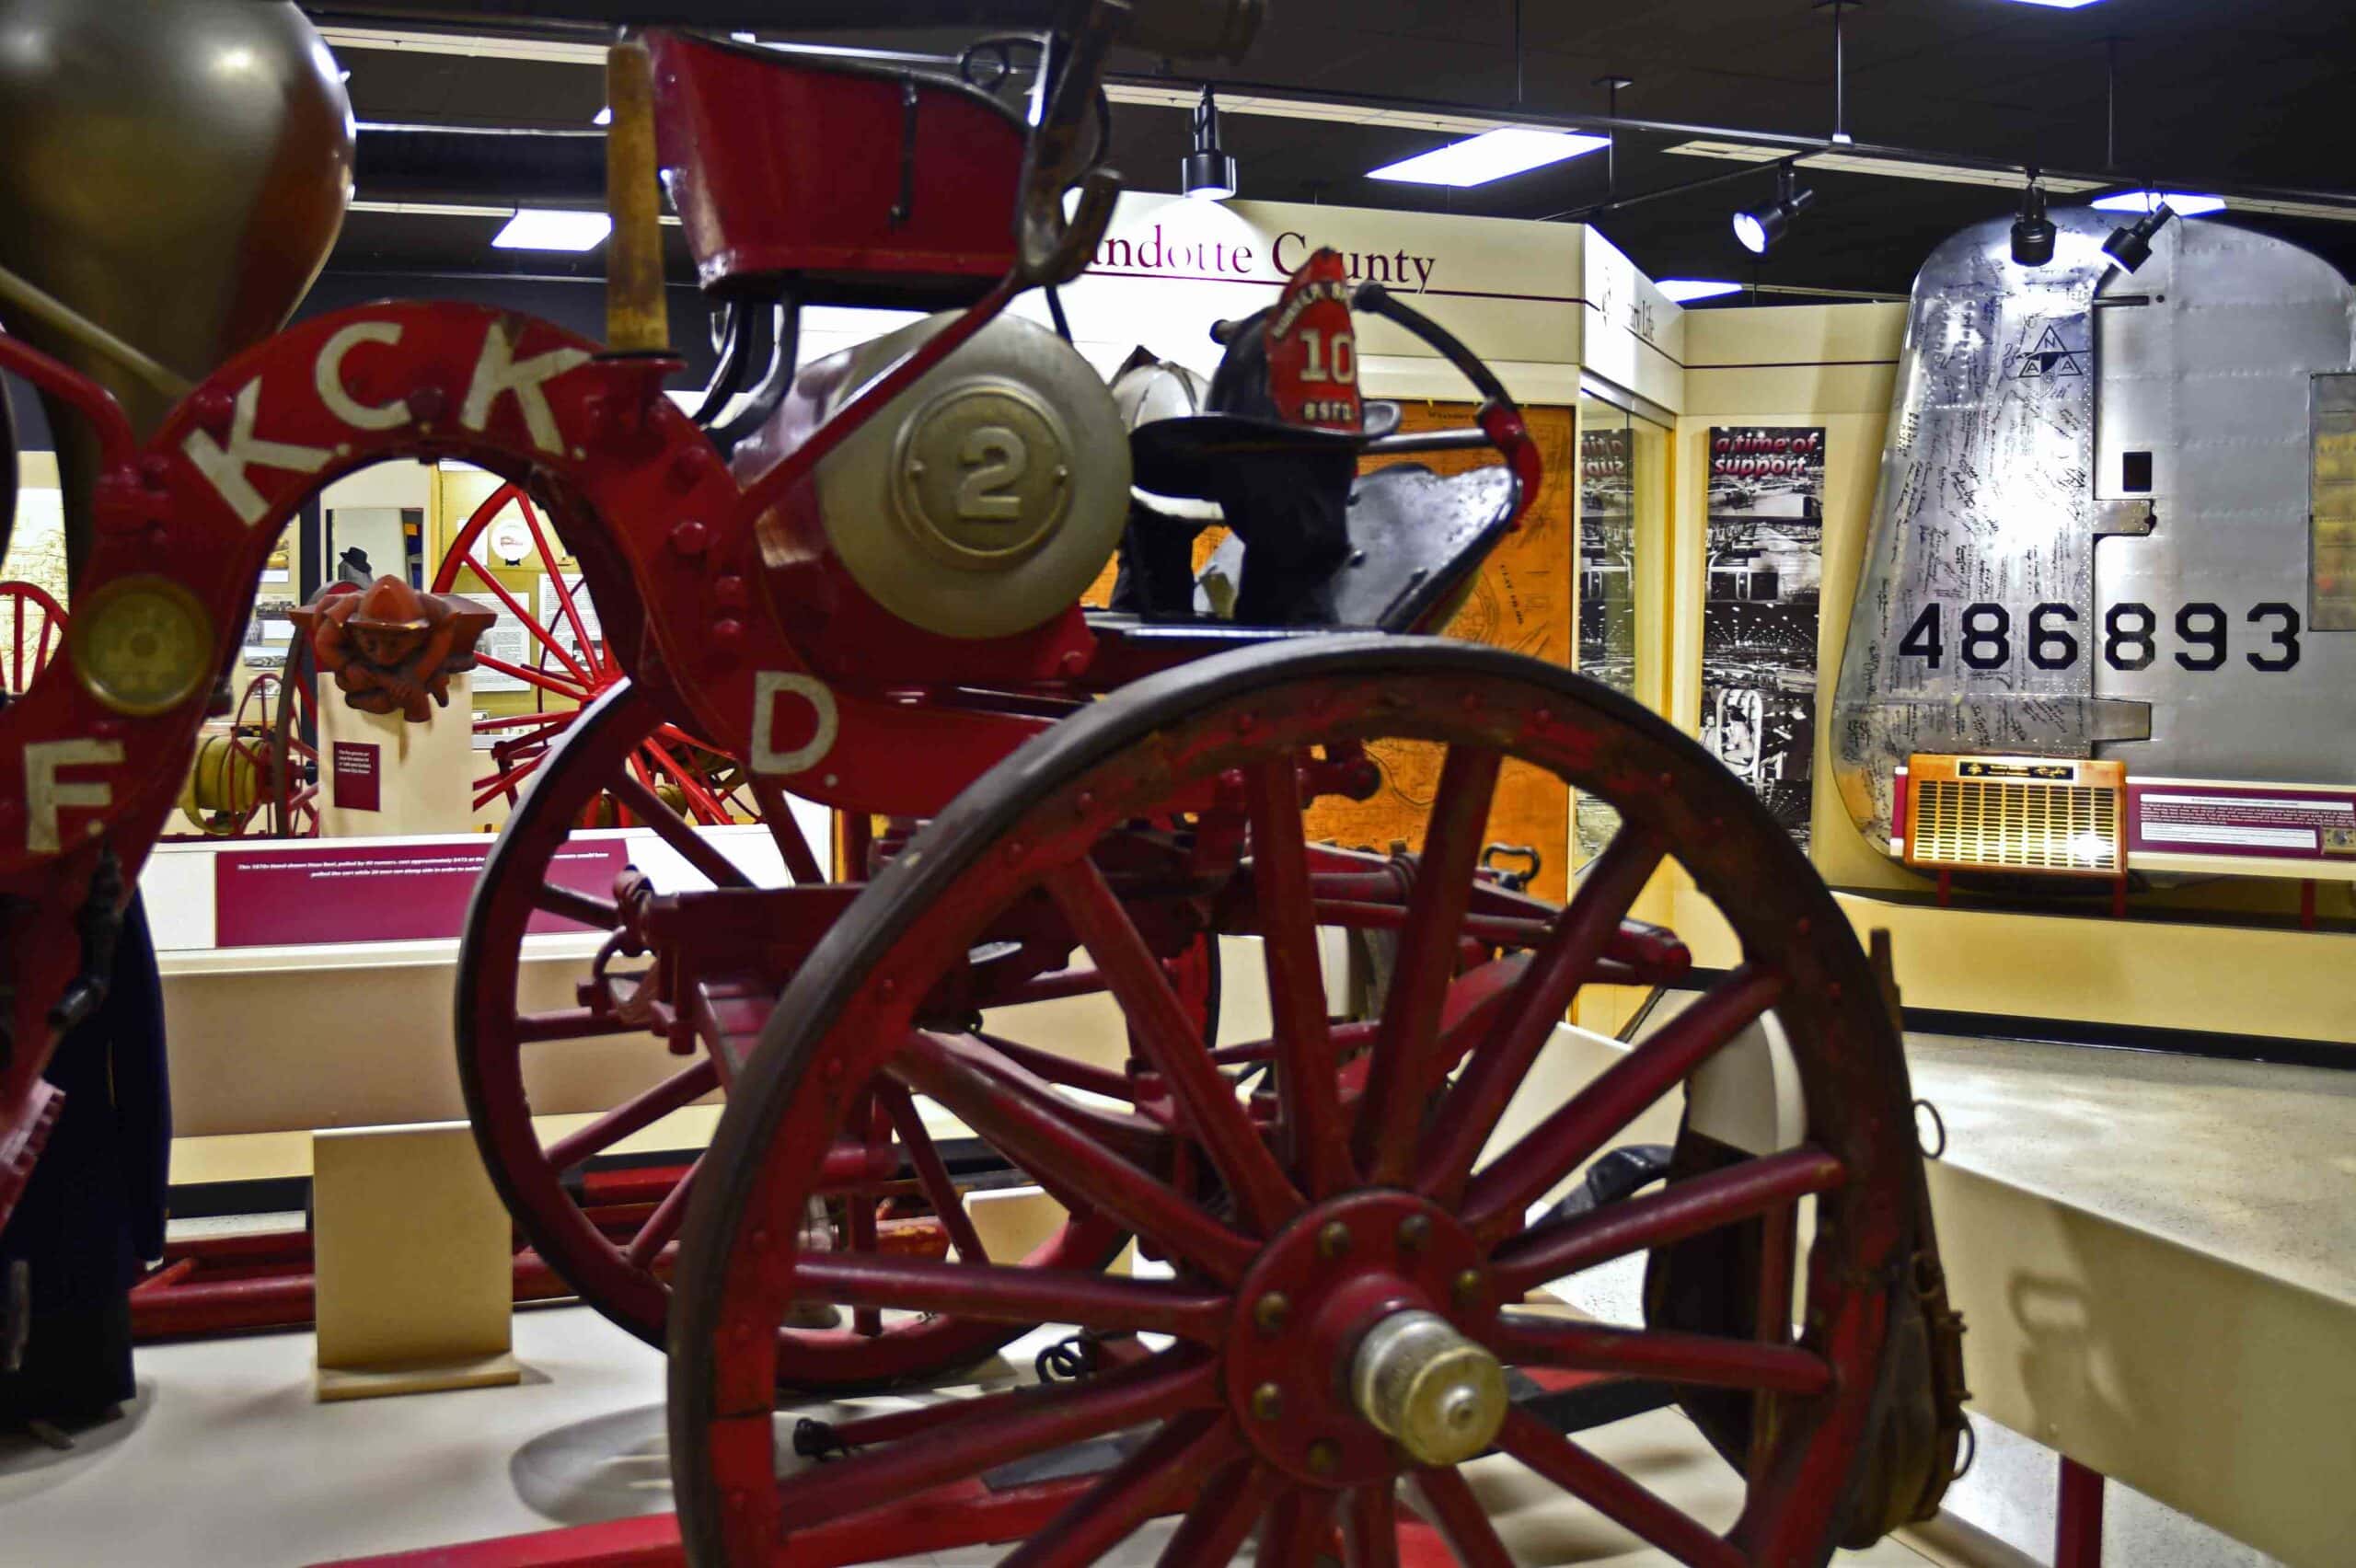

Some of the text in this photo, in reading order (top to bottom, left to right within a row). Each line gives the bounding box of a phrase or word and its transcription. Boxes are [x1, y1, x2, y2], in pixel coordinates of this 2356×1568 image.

[1272, 232, 1437, 294] Cunty
[1299, 329, 1357, 384] 10
[1715, 457, 1807, 478] support
[1734, 433, 1786, 453] time
[1792, 432, 1819, 453] of
[955, 425, 1027, 518] 2
